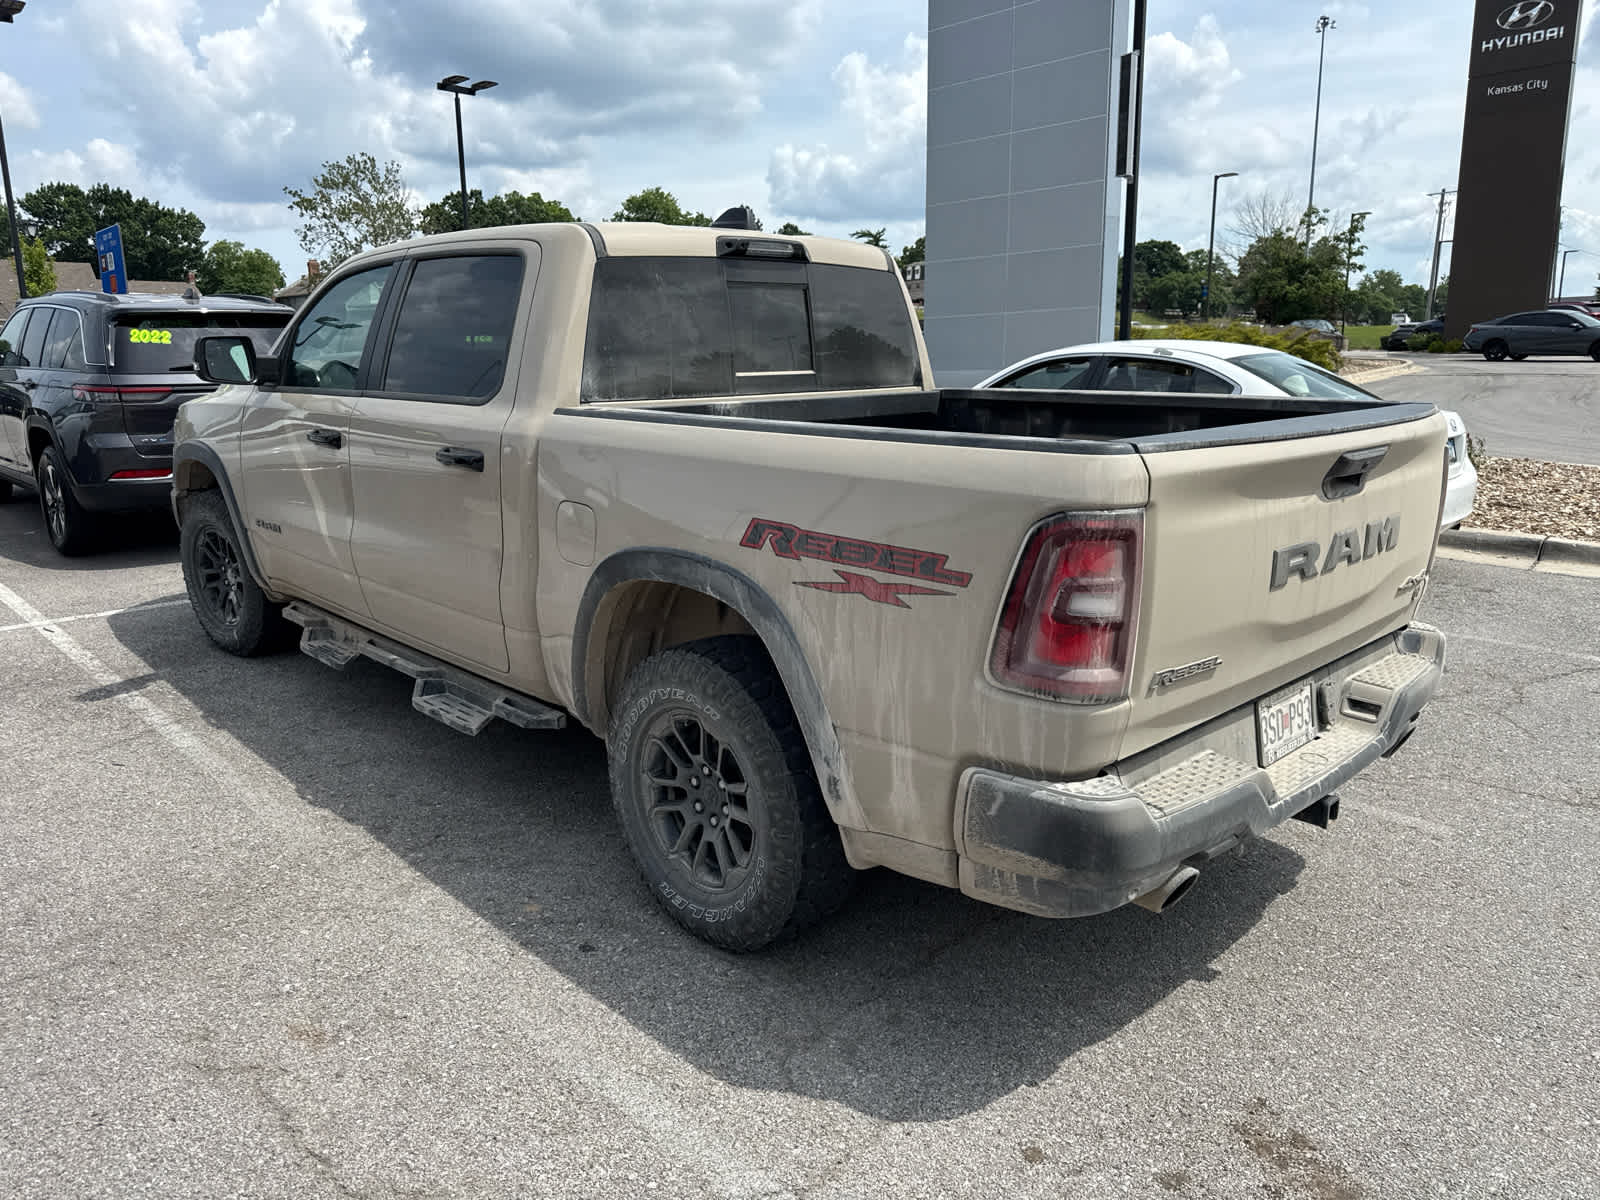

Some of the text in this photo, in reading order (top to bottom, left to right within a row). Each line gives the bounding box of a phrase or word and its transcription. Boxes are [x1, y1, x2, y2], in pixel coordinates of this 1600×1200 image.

[1481, 26, 1565, 53] HYUNDAI
[1487, 79, 1549, 96] Kansas City
[129, 328, 173, 344] 2022
[739, 517, 974, 588] REBEL
[1269, 512, 1400, 593] RAM
